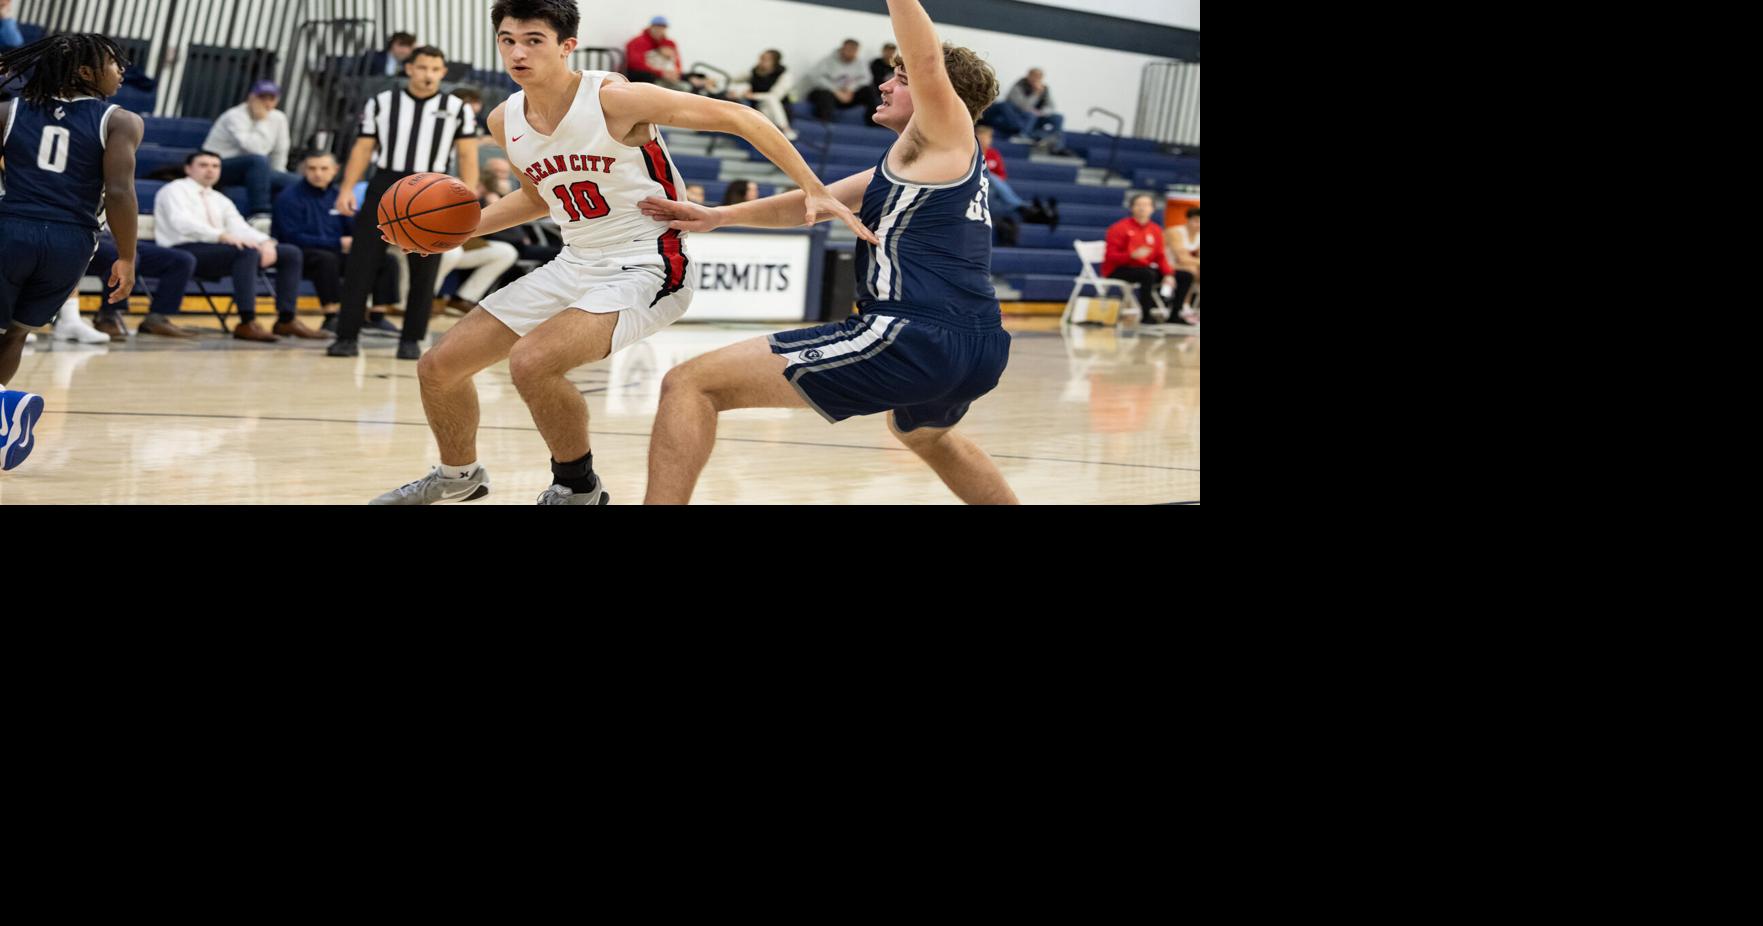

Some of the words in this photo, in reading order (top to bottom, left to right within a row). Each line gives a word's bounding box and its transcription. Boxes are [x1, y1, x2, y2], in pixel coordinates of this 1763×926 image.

[37, 125, 70, 173] 0
[569, 154, 616, 174] CITY
[552, 180, 611, 222] 10
